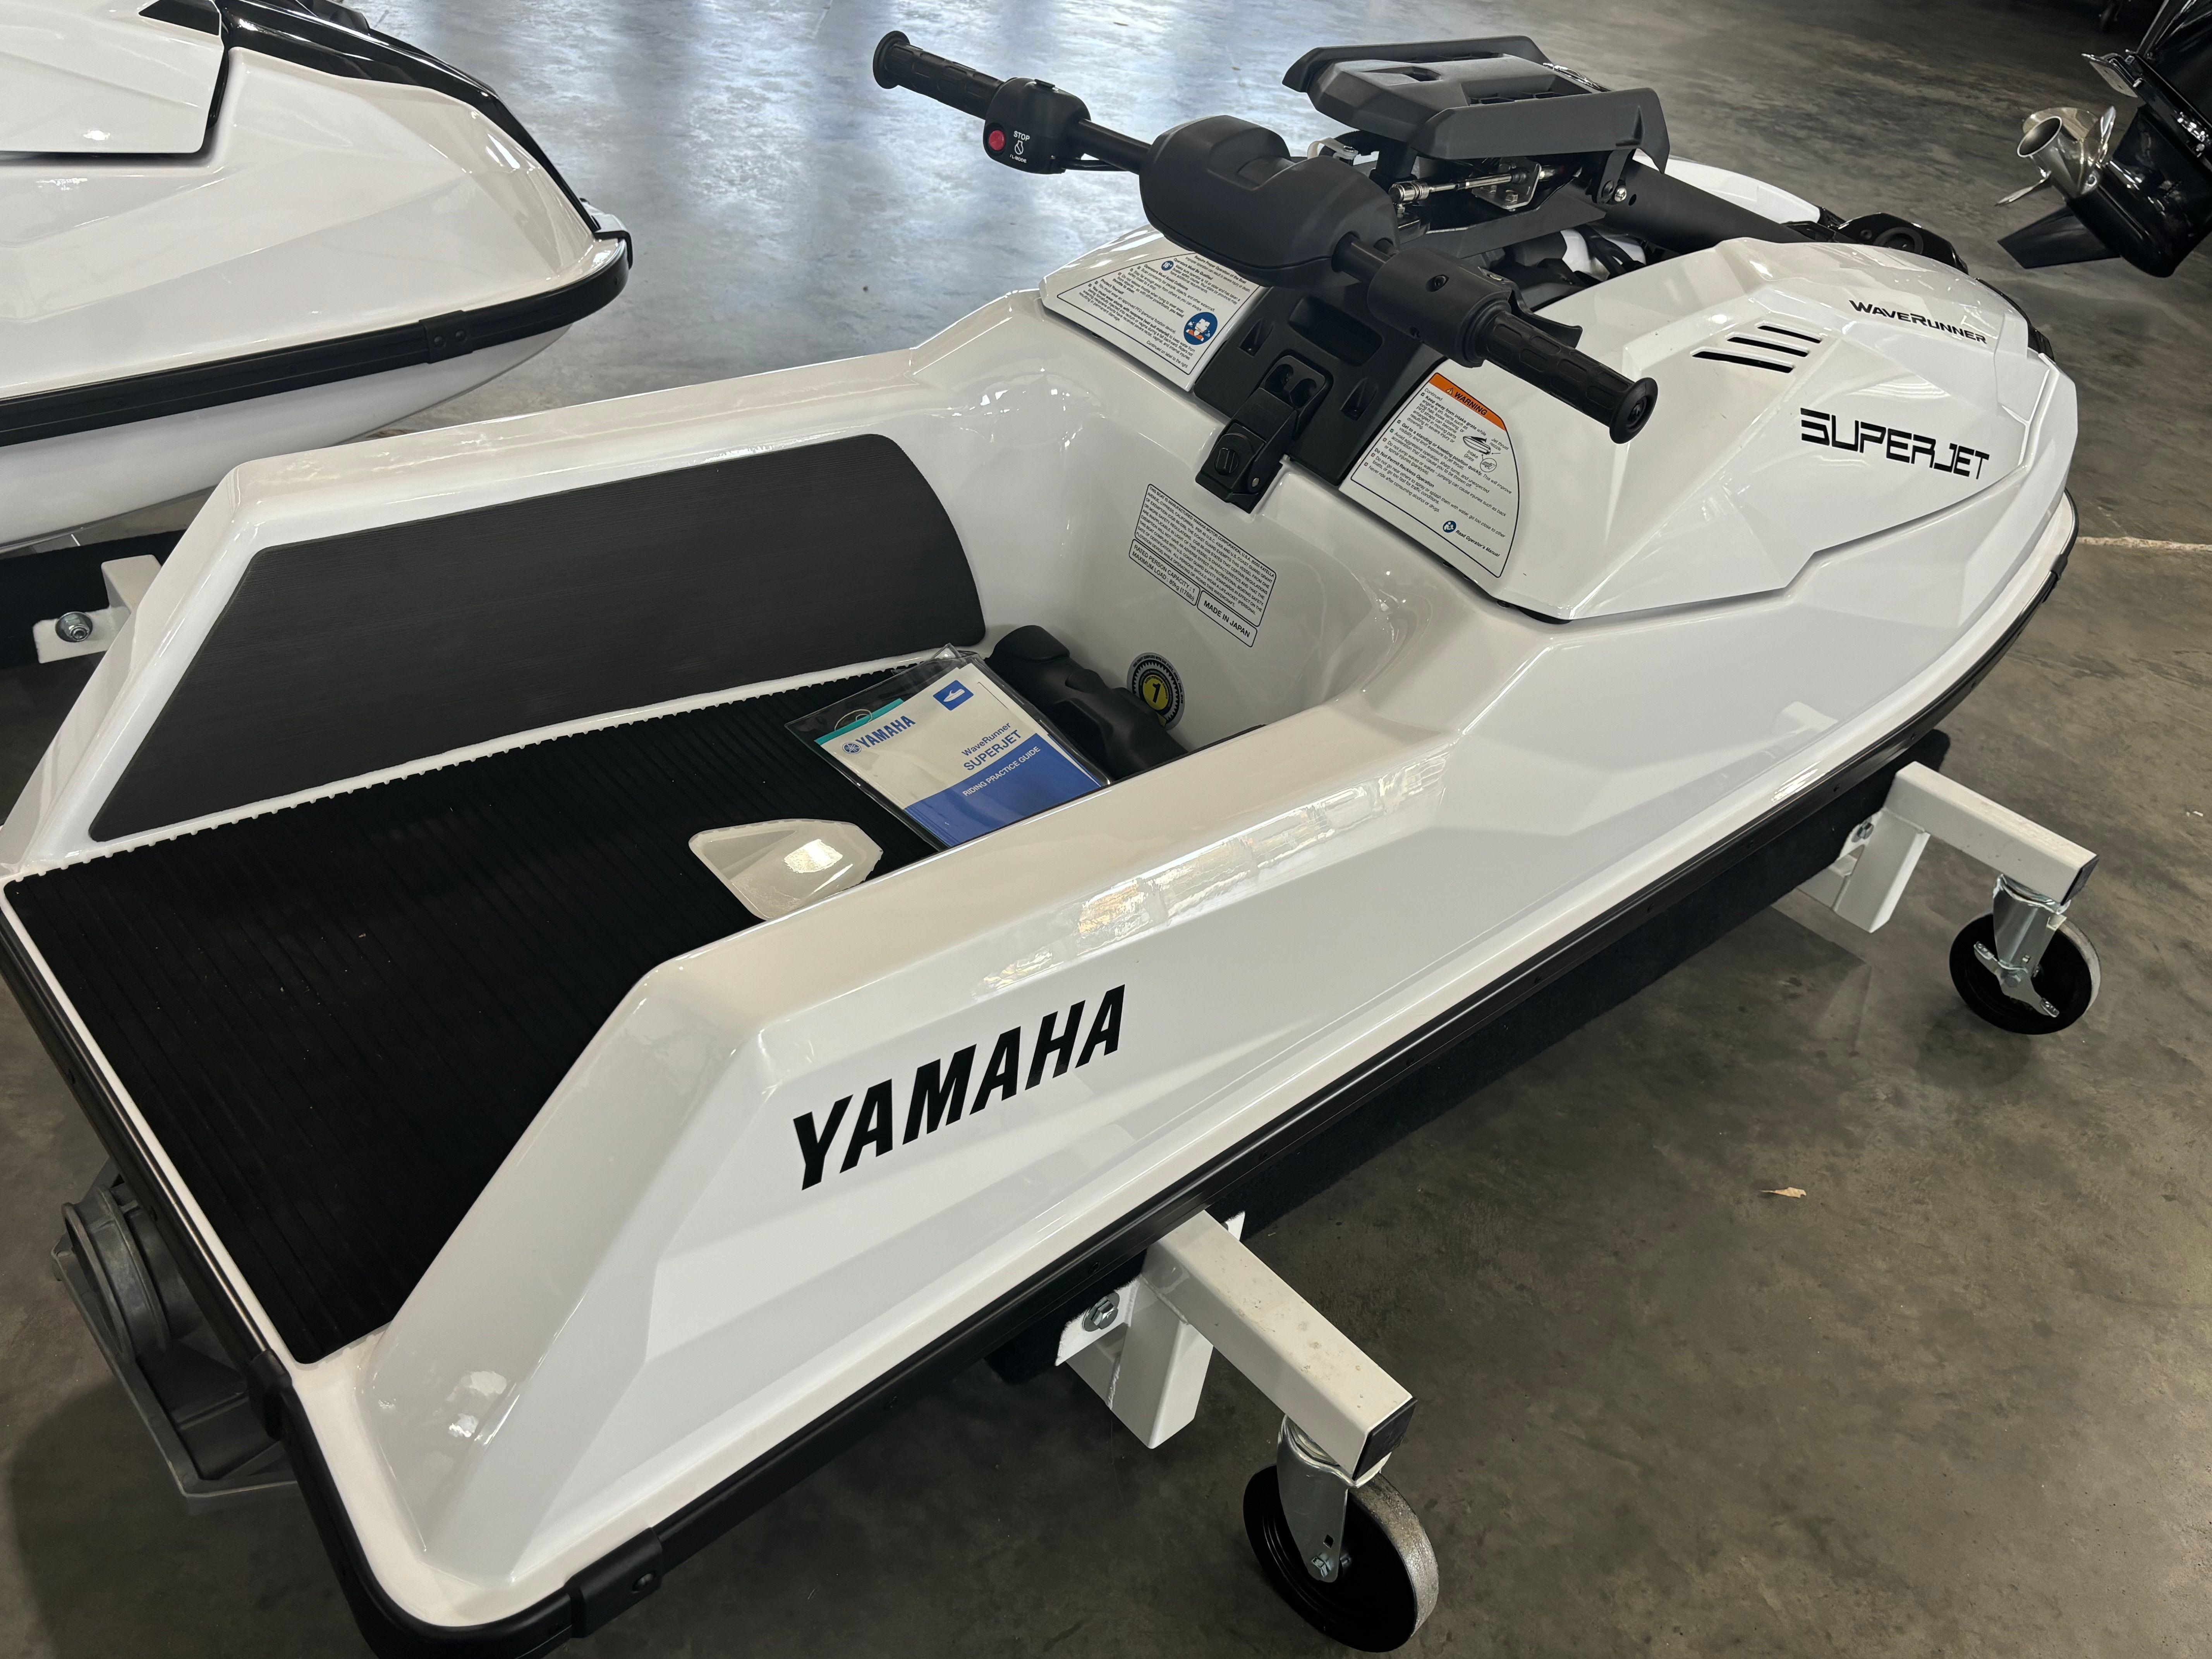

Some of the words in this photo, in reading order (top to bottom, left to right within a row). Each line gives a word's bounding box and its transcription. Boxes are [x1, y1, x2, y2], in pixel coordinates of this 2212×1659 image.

[1013, 131, 1030, 141] STOP
[1424, 388, 1443, 401] Continued
[1455, 392, 1487, 415] WARNING
[1454, 414, 1466, 423] intake
[1800, 408, 1990, 479] SUPERJET
[1387, 456, 1400, 465] Permit
[1399, 464, 1415, 476] Reckless
[1416, 474, 1434, 487] Operation
[1132, 551, 1153, 570] MAXIMUM
[1154, 568, 1166, 579] LOAD
[1134, 544, 1148, 558] RATED
[1149, 555, 1166, 572] PERSON
[1168, 570, 1189, 588] CAPACITY
[1486, 547, 1500, 556] Manual
[1204, 600, 1221, 617] MADE
[1222, 614, 1229, 622] IN
[1230, 620, 1250, 637] JAPAN
[1152, 683, 1161, 703] 1
[855, 716, 915, 747] YAMAHA
[962, 723, 1011, 756] WaveRunner
[963, 730, 1021, 771] SUPERJET
[962, 781, 988, 796] RIDING
[986, 761, 1020, 783] PRACTICE
[1018, 746, 1041, 763] GUIDE
[793, 984, 1125, 1190] YAMAHA
